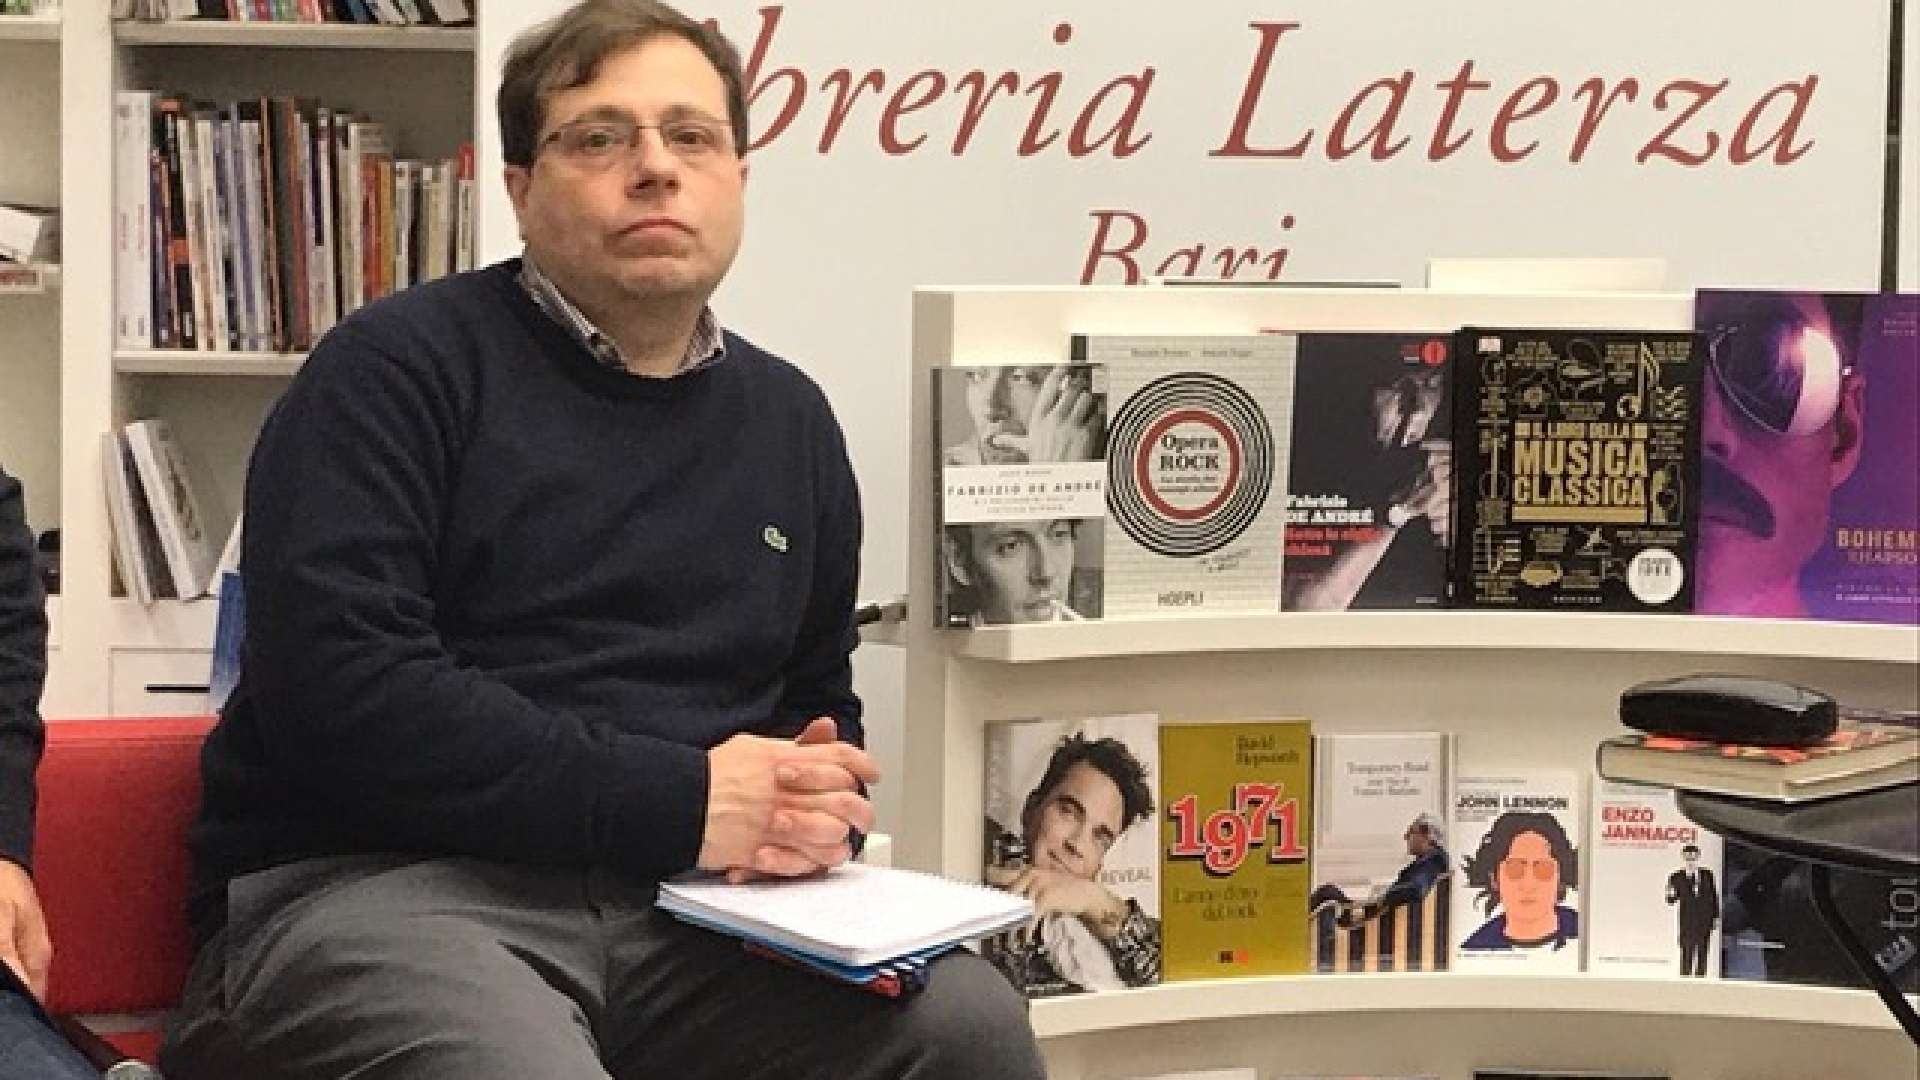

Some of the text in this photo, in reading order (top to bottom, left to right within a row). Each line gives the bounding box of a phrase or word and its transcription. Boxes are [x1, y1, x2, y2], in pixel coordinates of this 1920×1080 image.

[703, 5, 1819, 166] breria Laterza
[1080, 209, 1296, 285] Bari
[1160, 434, 1219, 453] Opera
[1159, 454, 1221, 471] ROCK
[1514, 440, 1648, 477] MUSICA
[947, 484, 1021, 497] FABRIZIO
[1513, 476, 1645, 505] CLASSICA
[1837, 528, 1917, 550] BOHEM
[1457, 796, 1569, 810] JOHN LENNON
[1602, 806, 1654, 822] ENZO
[1168, 782, 1307, 876] 1971
[1602, 825, 1697, 843] JANNACCI
